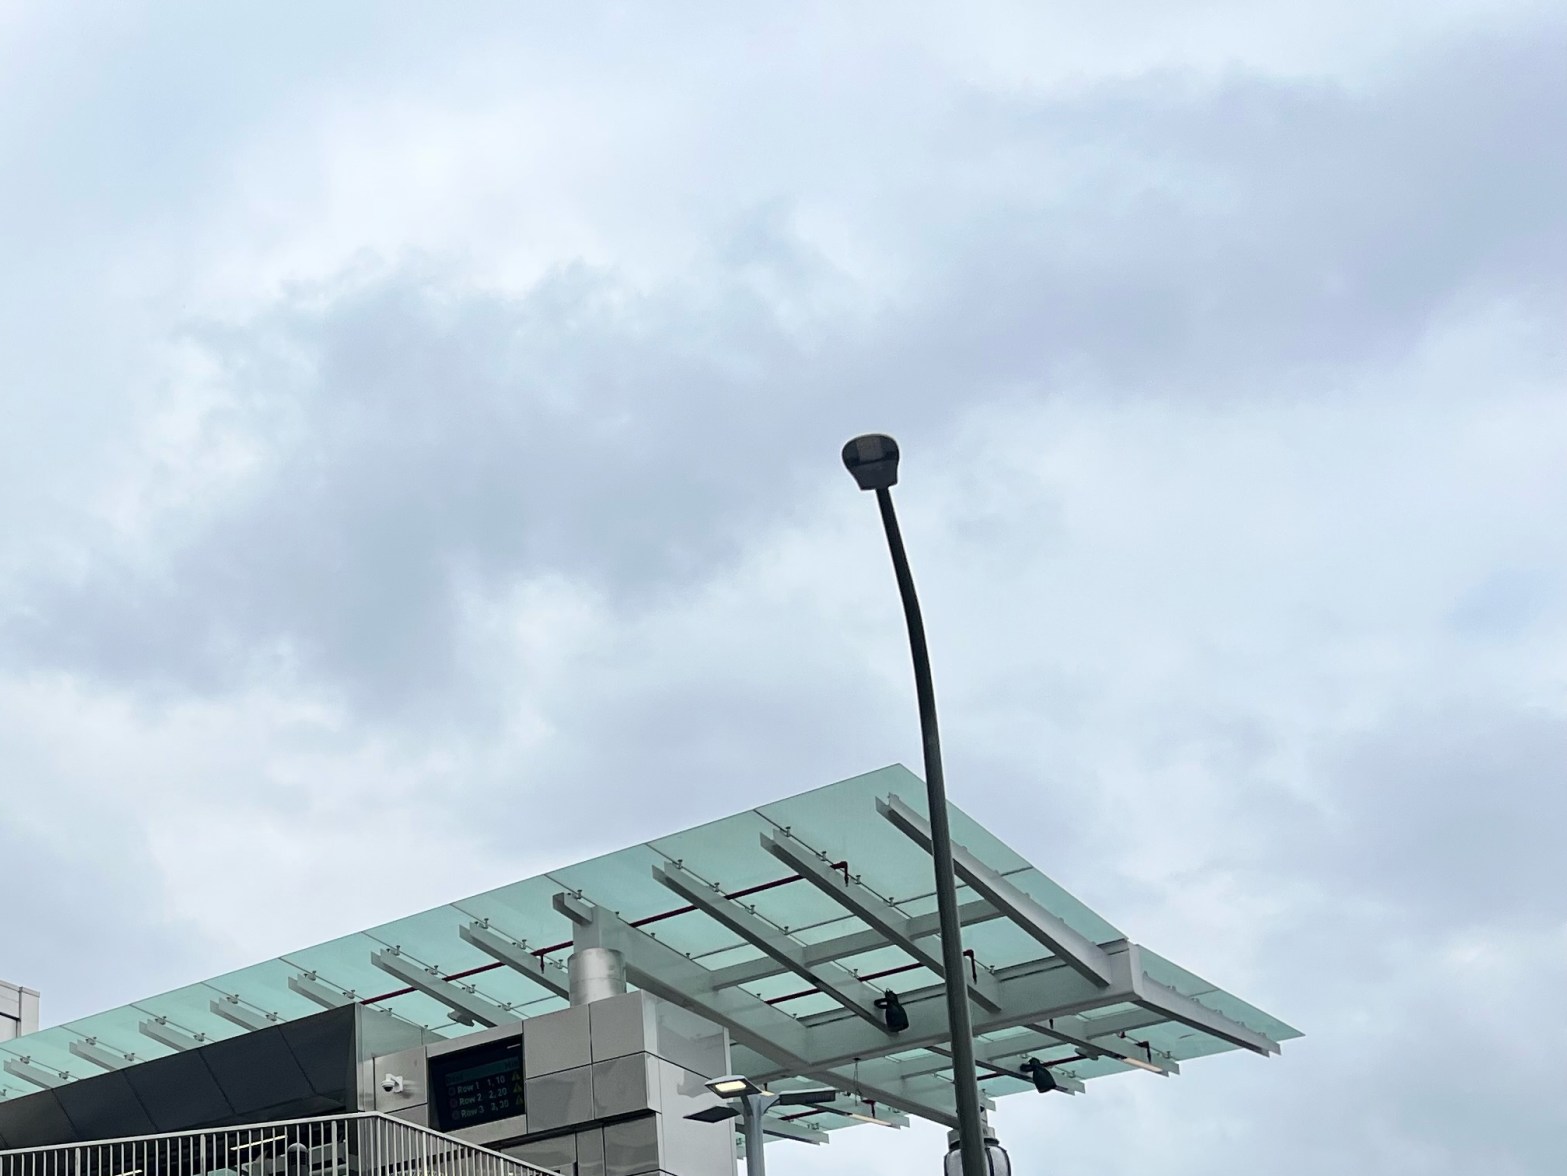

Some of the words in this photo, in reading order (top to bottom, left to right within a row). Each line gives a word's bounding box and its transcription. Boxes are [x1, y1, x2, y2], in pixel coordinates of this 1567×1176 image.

[457, 1085, 474, 1094] Row
[459, 1096, 476, 1106] Row
[477, 1093, 482, 1102] 2
[461, 1109, 478, 1118] Row
